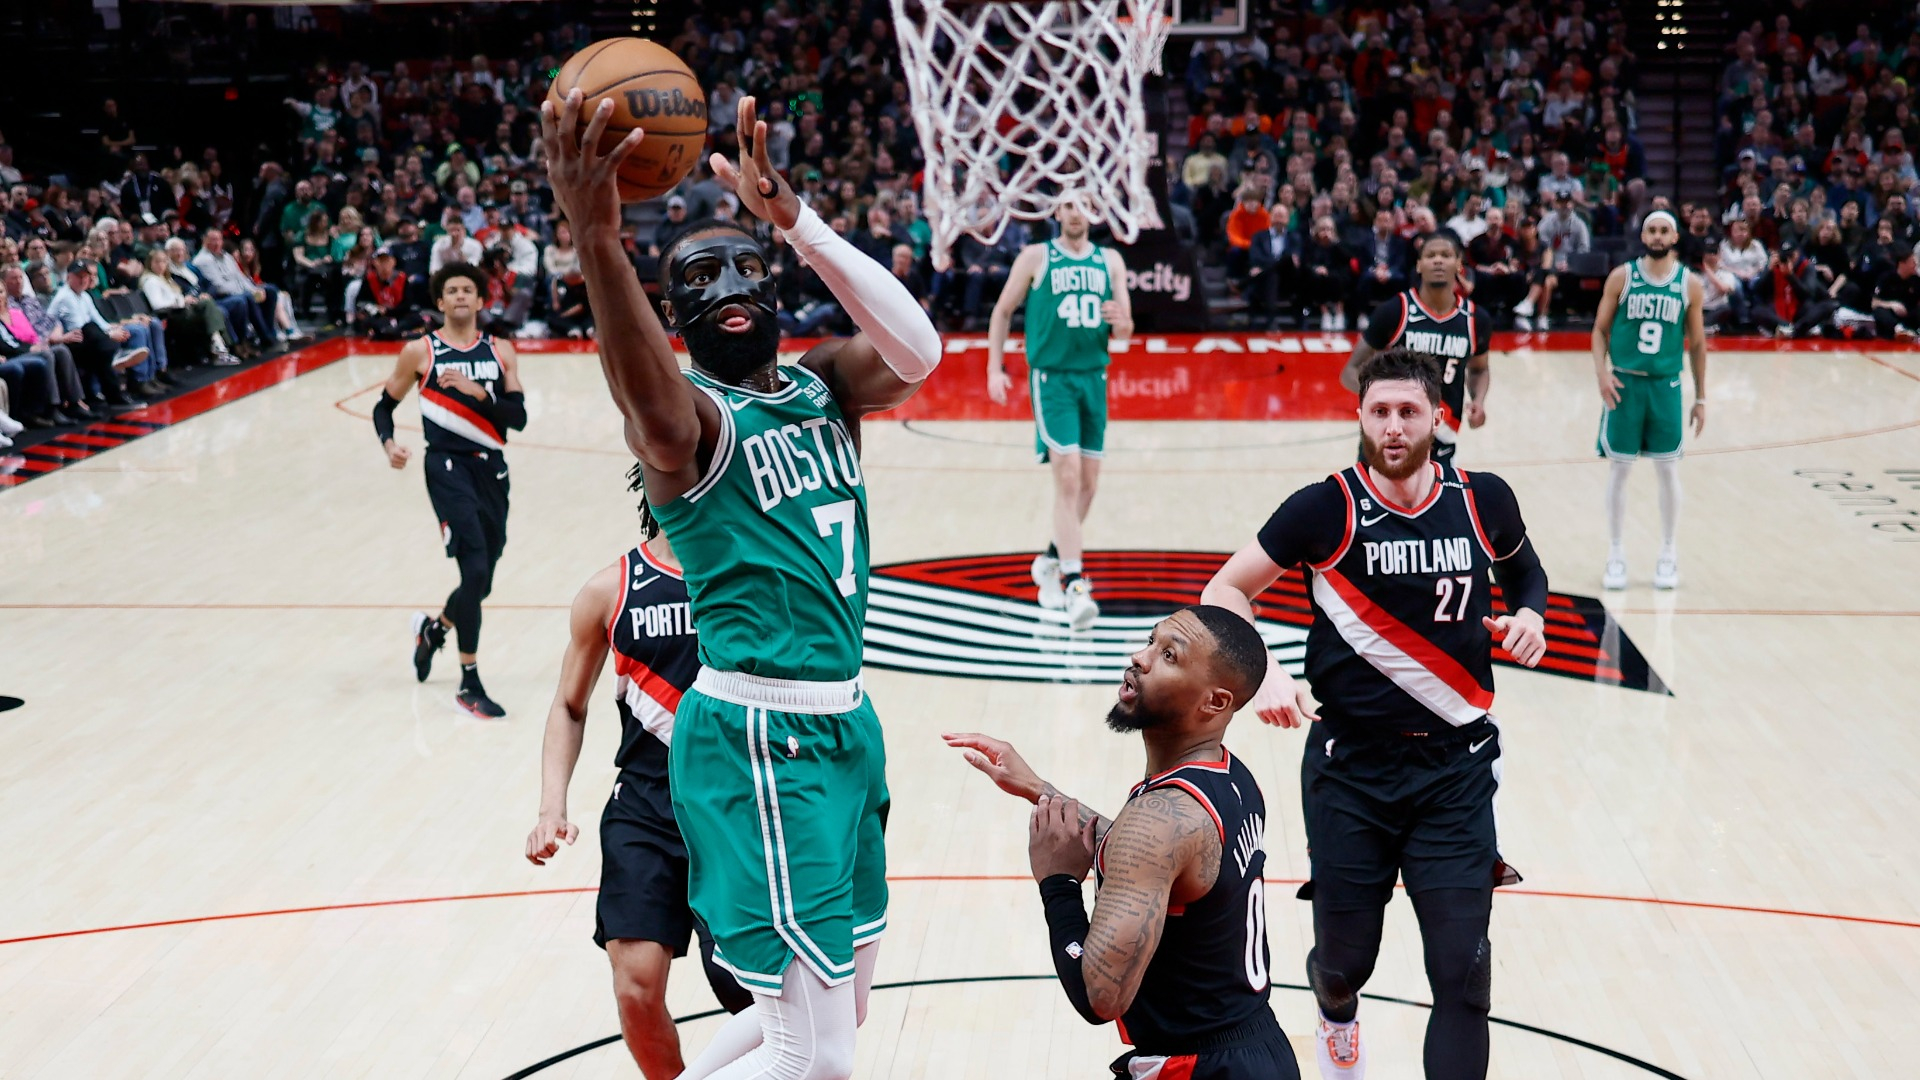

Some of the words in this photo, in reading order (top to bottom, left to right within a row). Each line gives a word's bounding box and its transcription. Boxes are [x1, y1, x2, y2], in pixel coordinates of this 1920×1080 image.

[1051, 266, 1106, 295] BOSTON
[1057, 294, 1102, 328] 40
[1627, 293, 1682, 325] BOSTON
[945, 338, 1353, 353] PTLAND
[1405, 331, 1469, 358] PORTLAND
[1637, 321, 1663, 354] 9
[435, 361, 499, 380] PTLAND
[742, 416, 863, 513] BOSTO
[1360, 498, 1371, 511] 6
[810, 498, 857, 598] 7
[1362, 537, 1472, 576] PORTLAND
[634, 563, 643, 576] 6
[1434, 575, 1473, 622] 27
[629, 602, 699, 640] PORTL
[1246, 876, 1268, 992] 0
